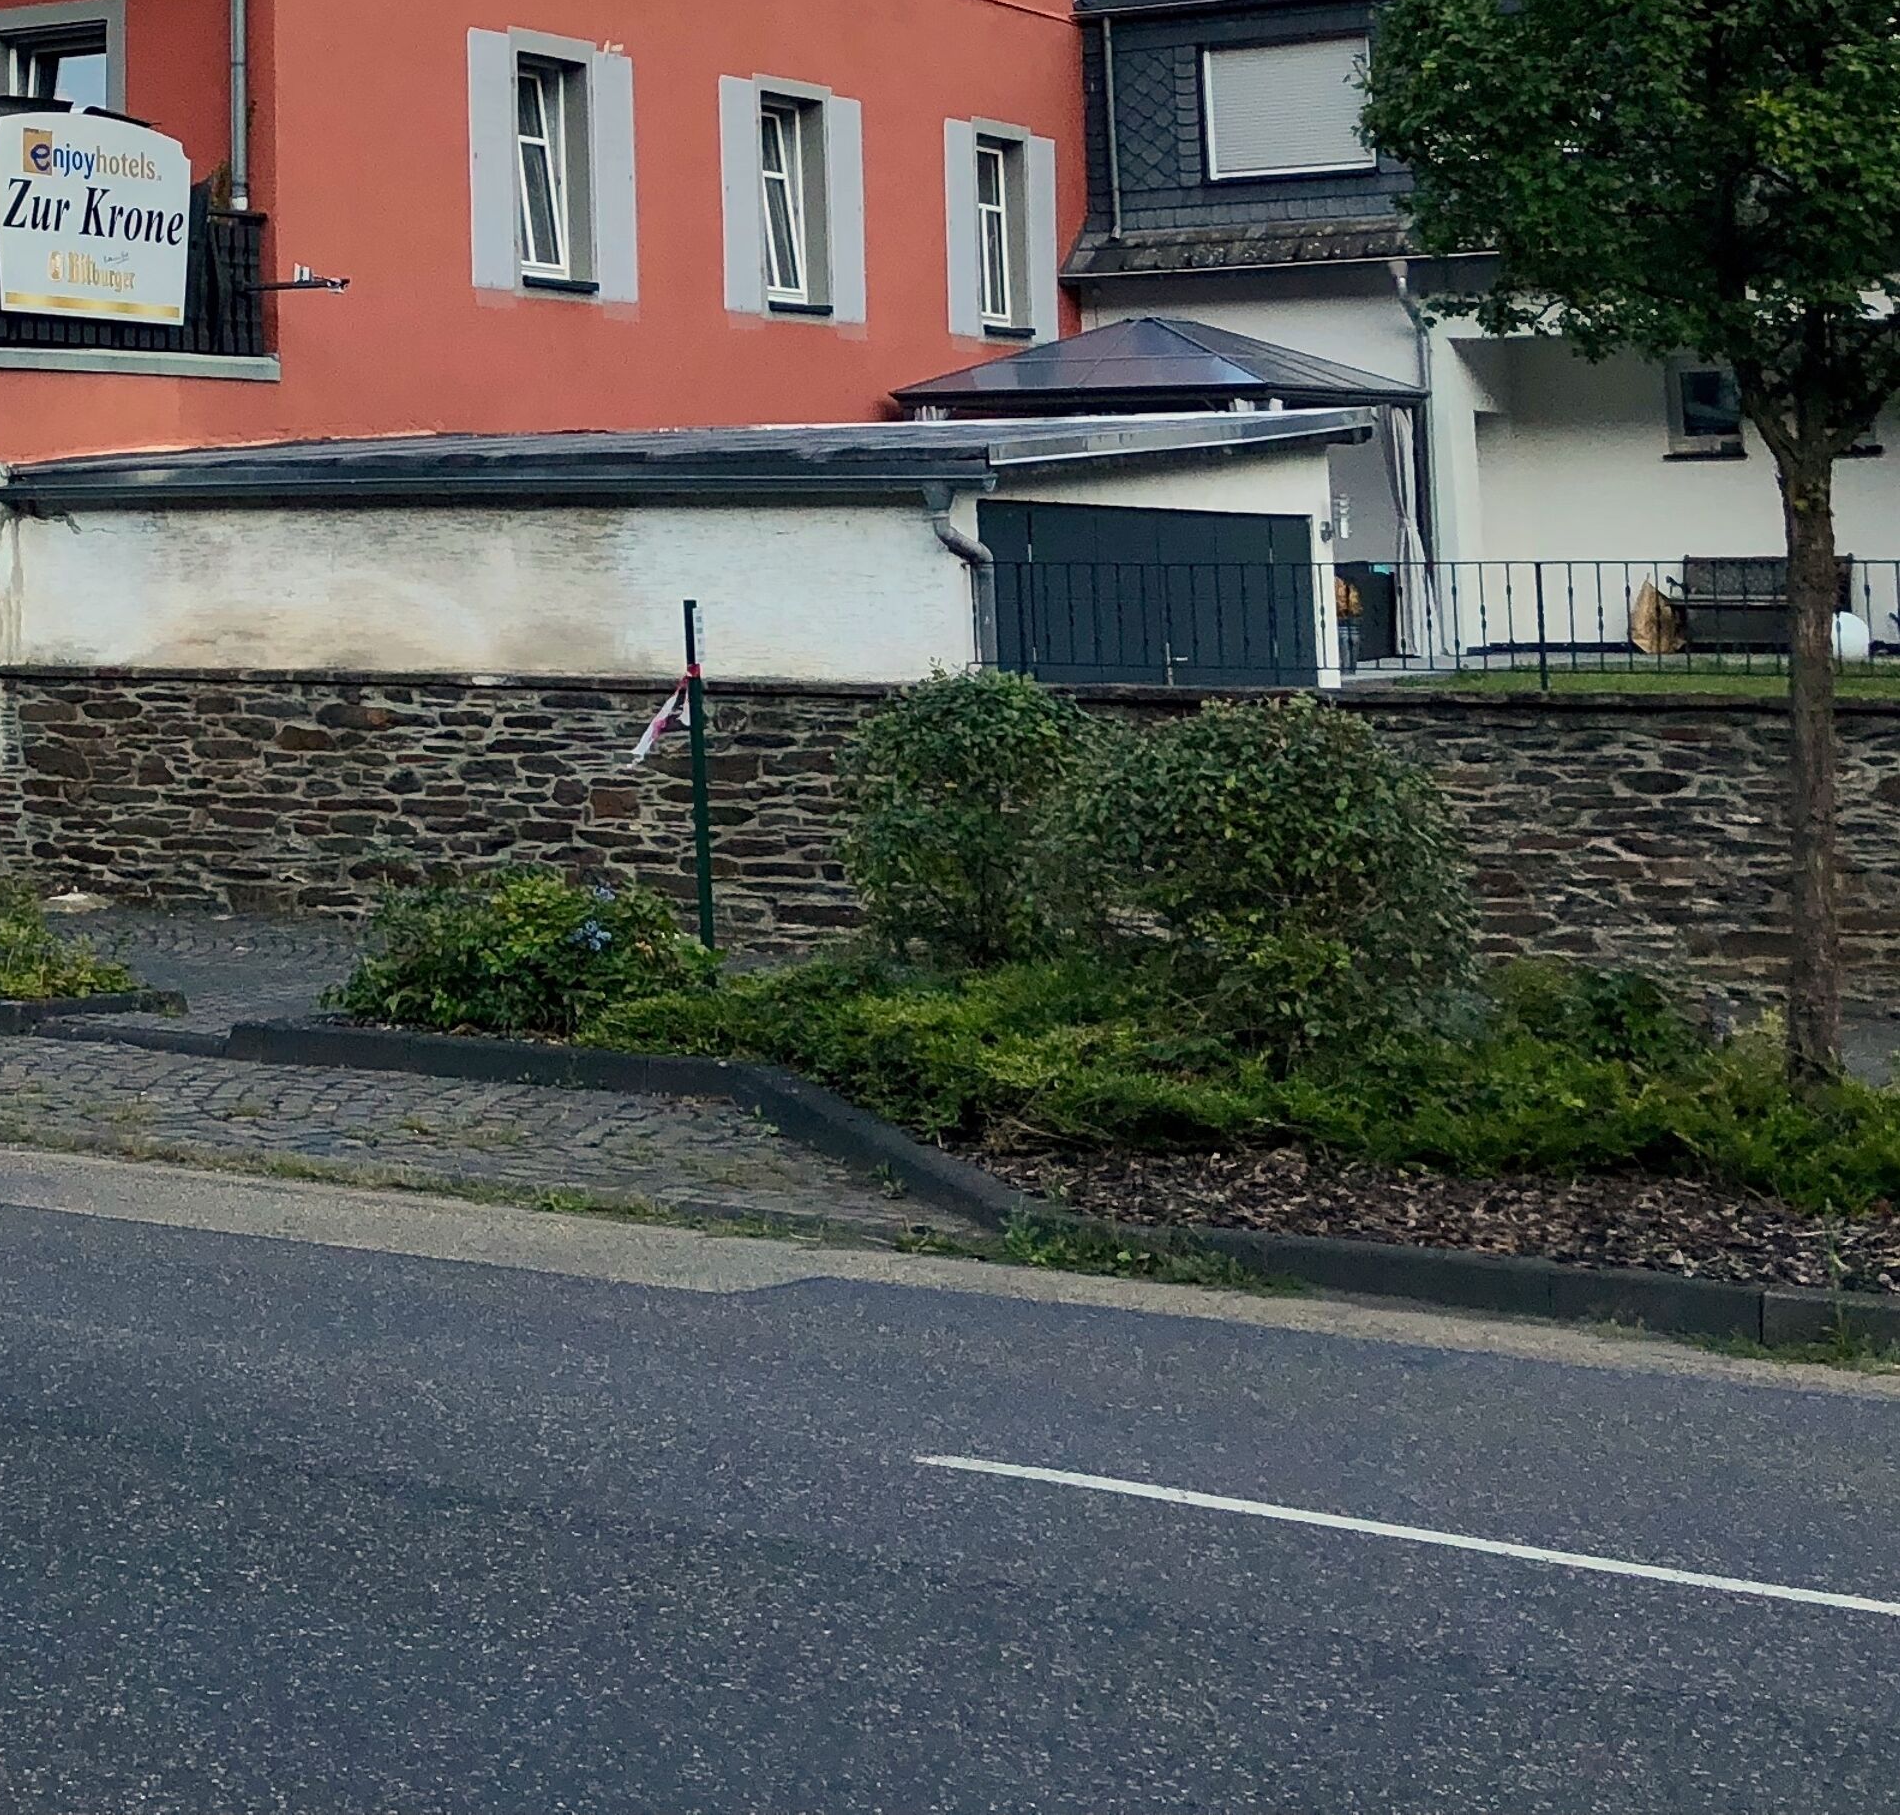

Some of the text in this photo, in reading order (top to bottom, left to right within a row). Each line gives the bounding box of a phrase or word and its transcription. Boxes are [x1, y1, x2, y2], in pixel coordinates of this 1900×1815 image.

[2, 177, 185, 247] Zur Krone
[68, 250, 136, 293] Bitburger
